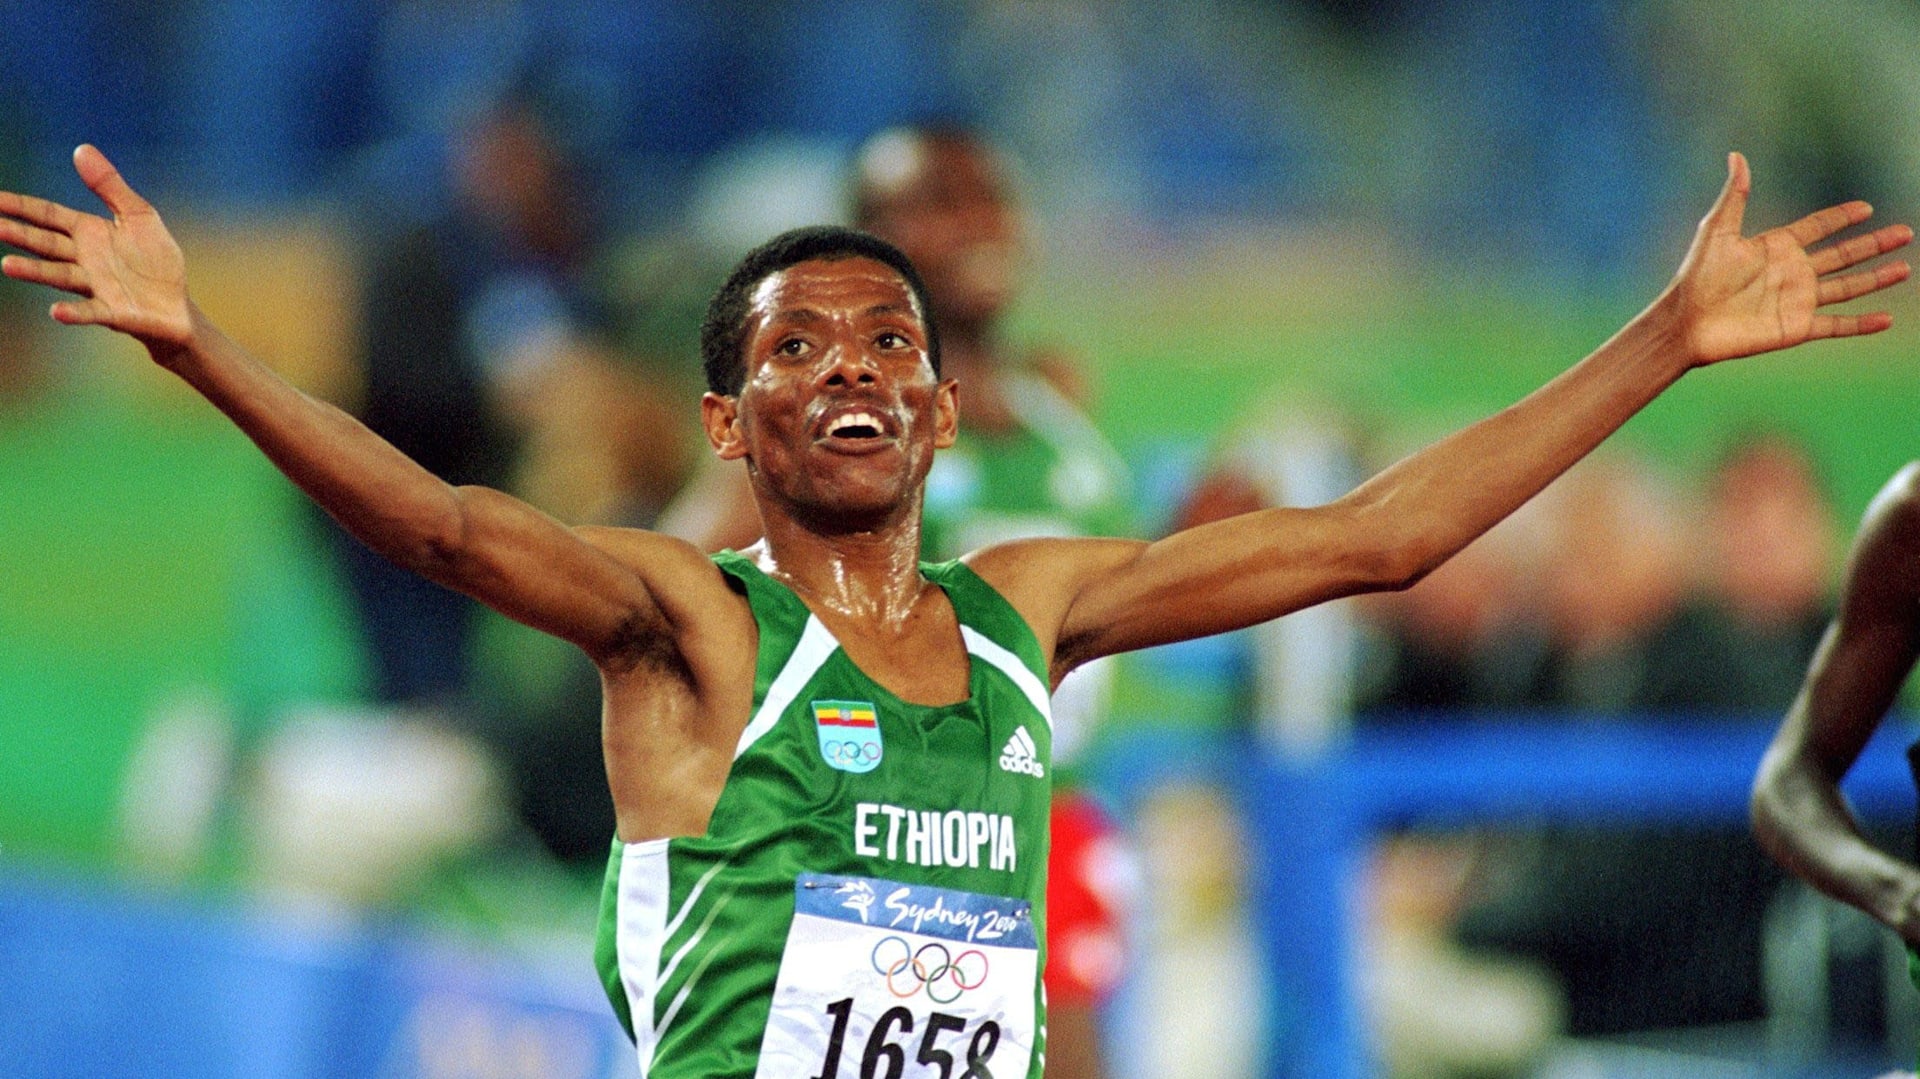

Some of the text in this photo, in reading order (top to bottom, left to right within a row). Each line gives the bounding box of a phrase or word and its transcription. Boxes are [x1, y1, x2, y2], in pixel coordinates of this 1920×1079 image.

[999, 754, 1044, 778] adidas
[855, 803, 1016, 872] ETHIOPIA
[885, 887, 1017, 942] Sydney 2000
[811, 997, 1000, 1079] 1658
